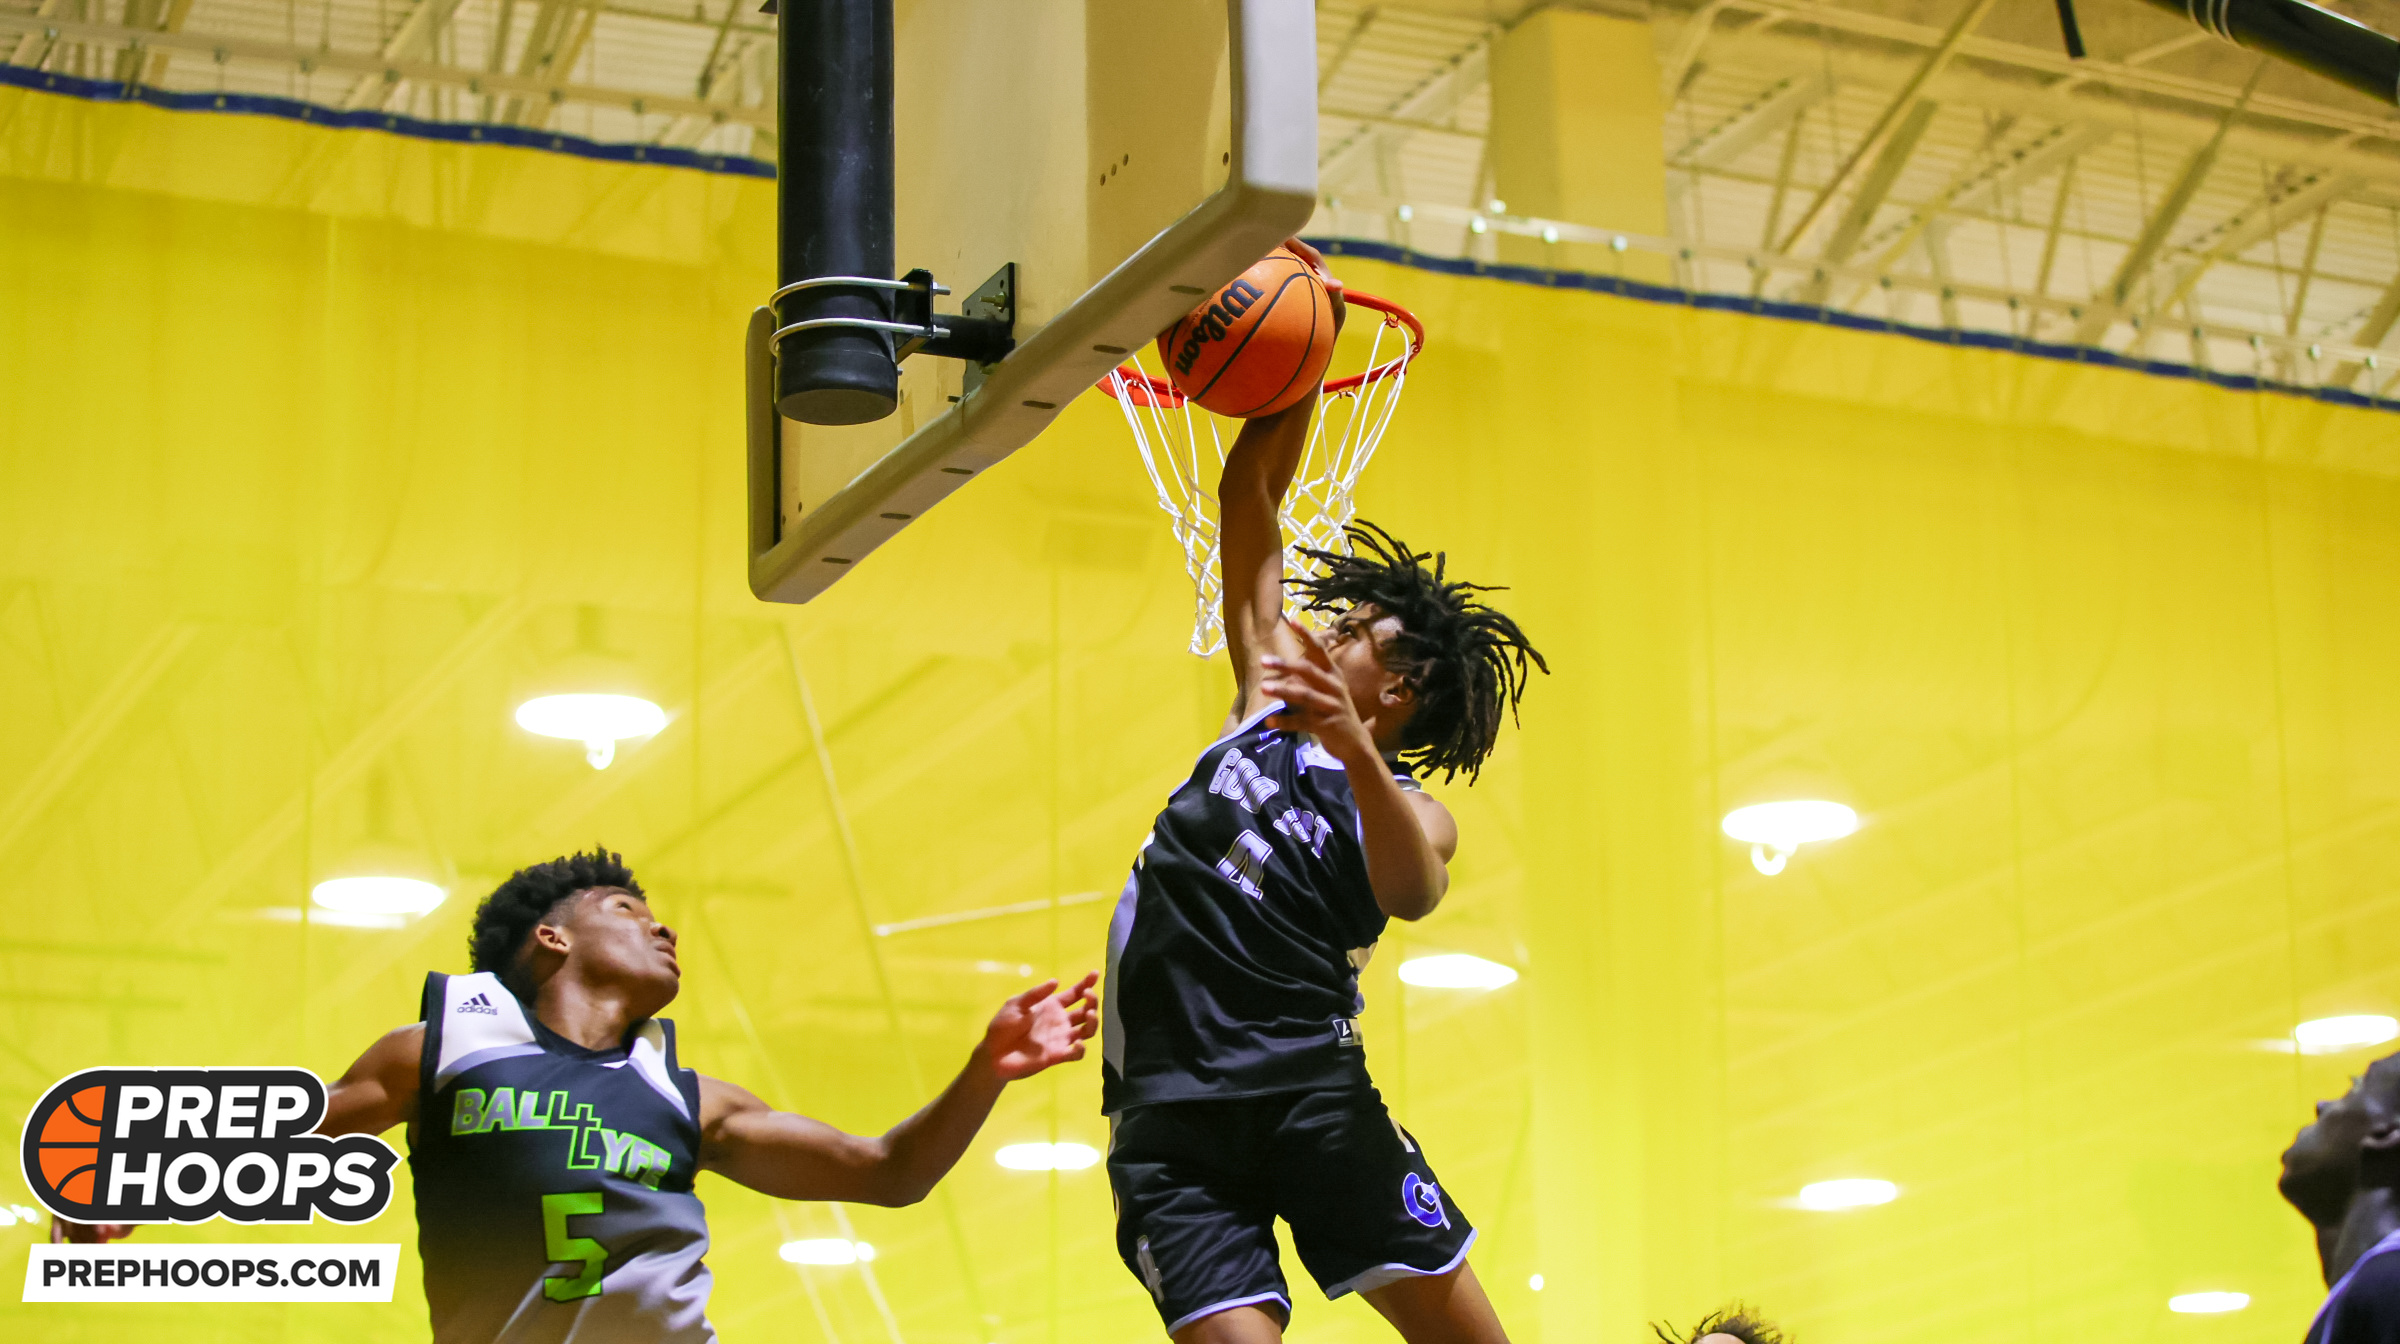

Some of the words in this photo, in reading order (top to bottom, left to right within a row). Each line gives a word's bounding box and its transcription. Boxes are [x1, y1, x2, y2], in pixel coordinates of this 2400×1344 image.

[1175, 279, 1264, 376] Wilson
[457, 1005, 498, 1016] adidas
[541, 1192, 609, 1302] 5
